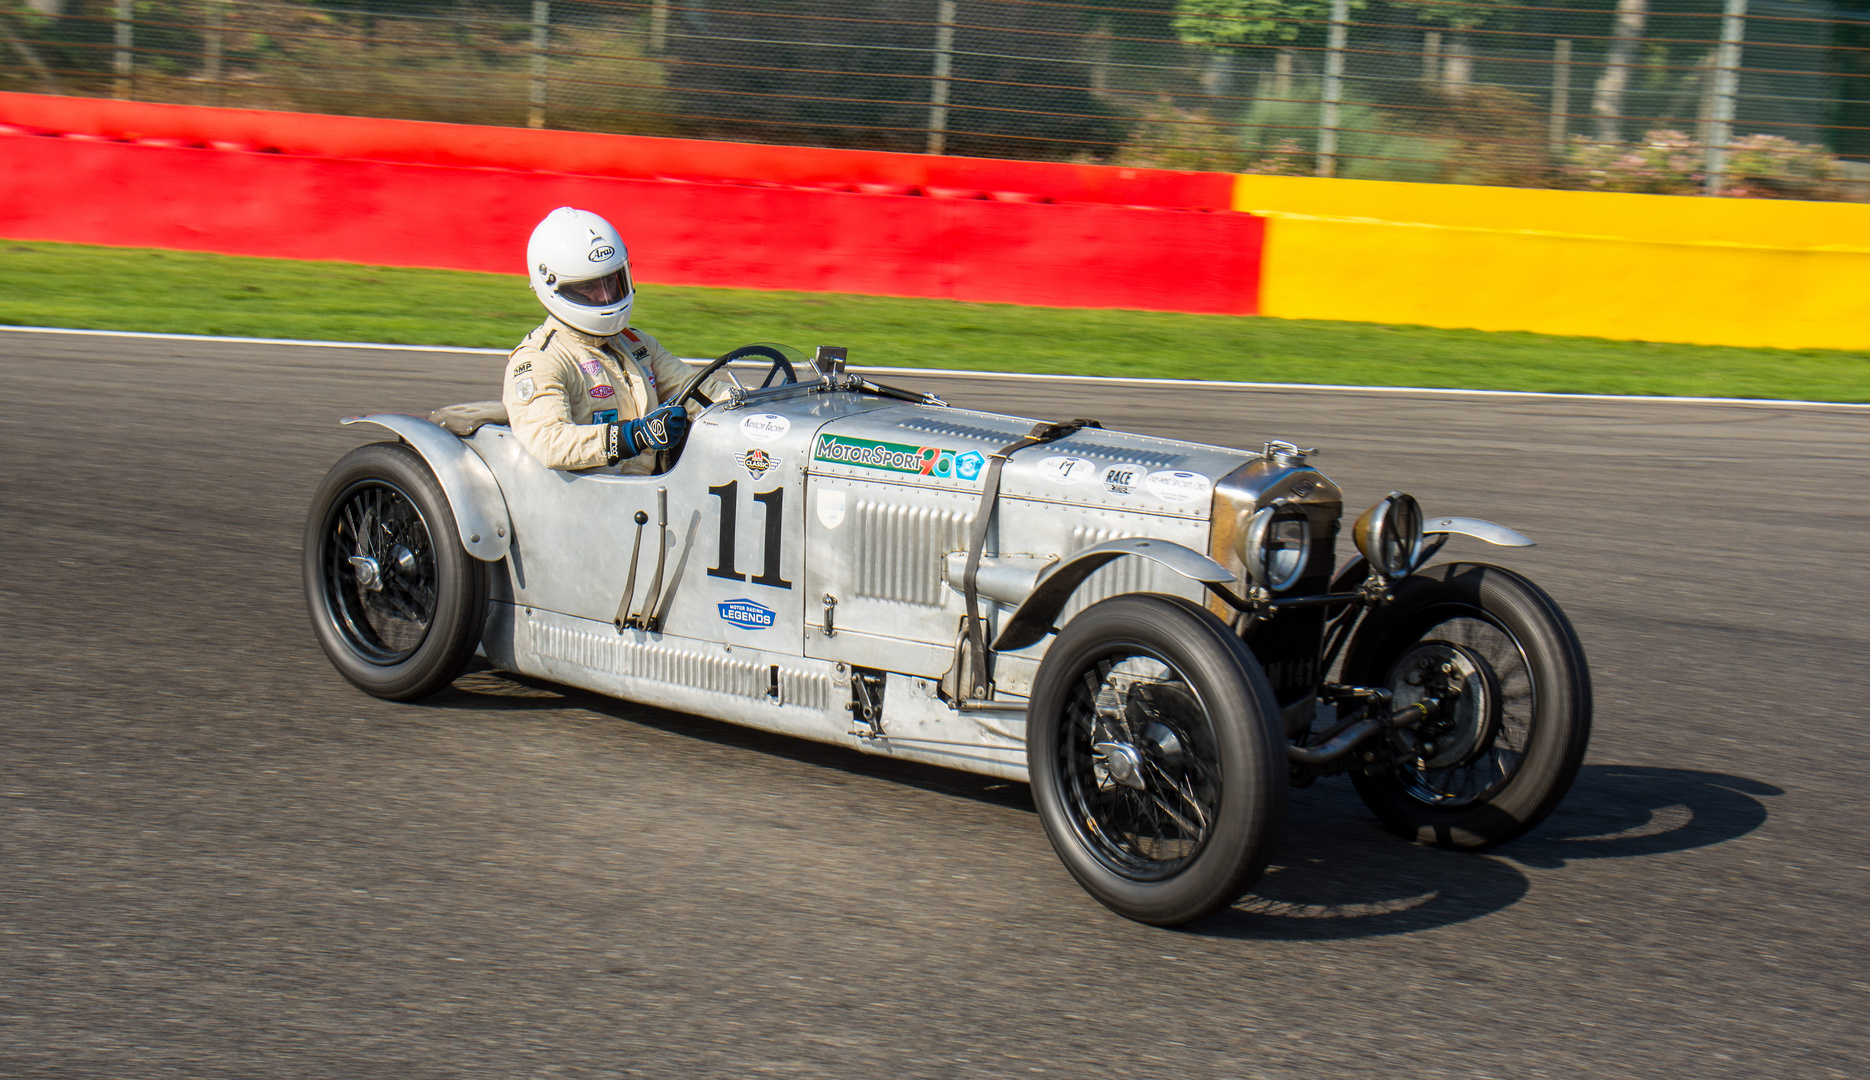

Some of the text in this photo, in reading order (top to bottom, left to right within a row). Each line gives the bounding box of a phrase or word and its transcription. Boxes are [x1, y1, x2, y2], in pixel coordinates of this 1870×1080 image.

[591, 247, 612, 261] Arai
[1105, 469, 1133, 485] RACE
[707, 479, 792, 590] 11
[722, 608, 771, 625] LEGENDS
